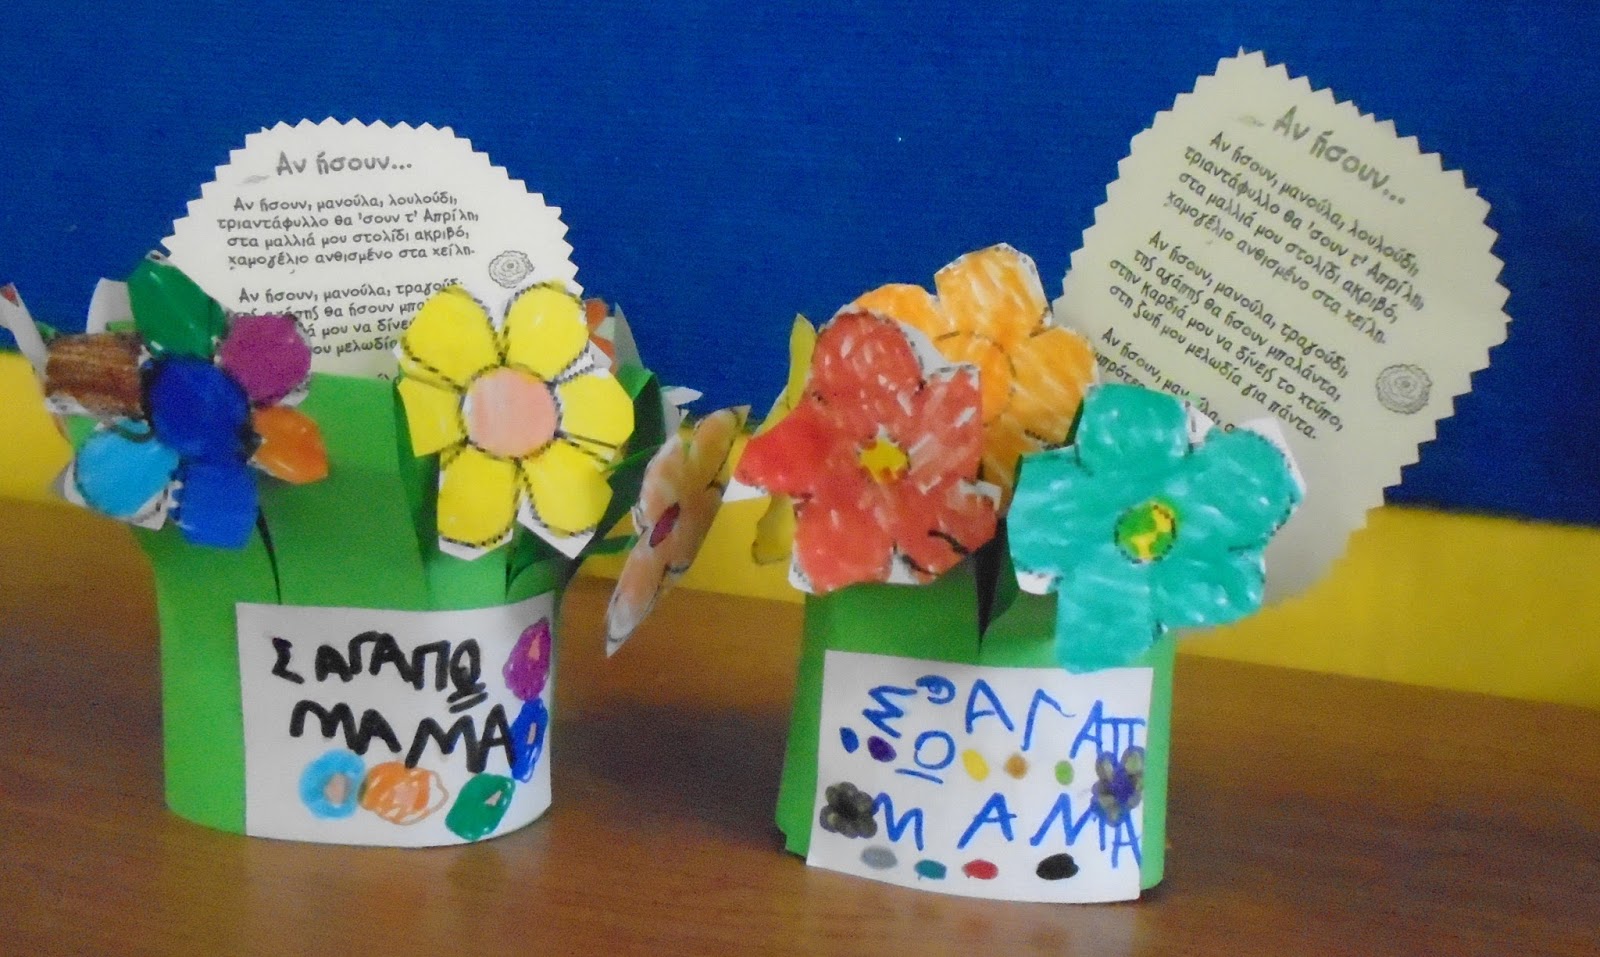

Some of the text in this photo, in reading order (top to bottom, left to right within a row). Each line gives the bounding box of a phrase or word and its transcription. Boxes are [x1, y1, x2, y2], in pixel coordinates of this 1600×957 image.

[276, 151, 412, 175] Αν ήσουν...
[1273, 105, 1406, 205] Αν ήσουν...
[217, 215, 328, 232] τριαντάφυλλο
[334, 215, 353, 226] θα
[424, 208, 479, 224] Απρίλη,
[227, 225, 469, 250] στα μαλλιά μου στολίδι ακριβό,
[234, 191, 457, 212] Αν ήσουν, μανούλα, λουλούδι,
[1184, 146, 1280, 214] τριαντάφυλλο
[1283, 210, 1302, 230] θα
[1366, 261, 1424, 311] Απρίλη,
[1210, 131, 1419, 277] Αν ήσουν, μανούλα, λουλούδι,
[228, 243, 475, 269] χαμογέλιο ανθισμένο στα χείλη.
[1167, 190, 1386, 344] χαμογέλιο ανθισμένο στα χείλη.
[1179, 172, 1398, 324] στα μαλλιά μου στολίδι ακριβό,
[239, 287, 259, 303] Αν
[265, 288, 318, 303] ήσουν,
[324, 284, 391, 302] μανούλα,
[324, 306, 343, 317] θα
[349, 302, 394, 317] ήσουν
[1134, 249, 1341, 402] της αγάπης θα ήσουν μπαλάντα,
[1148, 230, 1348, 378] Αν ήσουν, μανούλα, τραγούδι,
[322, 325, 348, 339] μου
[353, 323, 371, 333] να
[1101, 327, 1120, 348] Αν
[1120, 342, 1162, 384] ήσουν,
[1109, 260, 1343, 432] στην καρδιά μου να δίνεις το χτύπο,
[1109, 285, 1317, 439] στη ζωή μου μελωδία για πάντα.
[290, 700, 516, 773] ΜΑΜΑ
